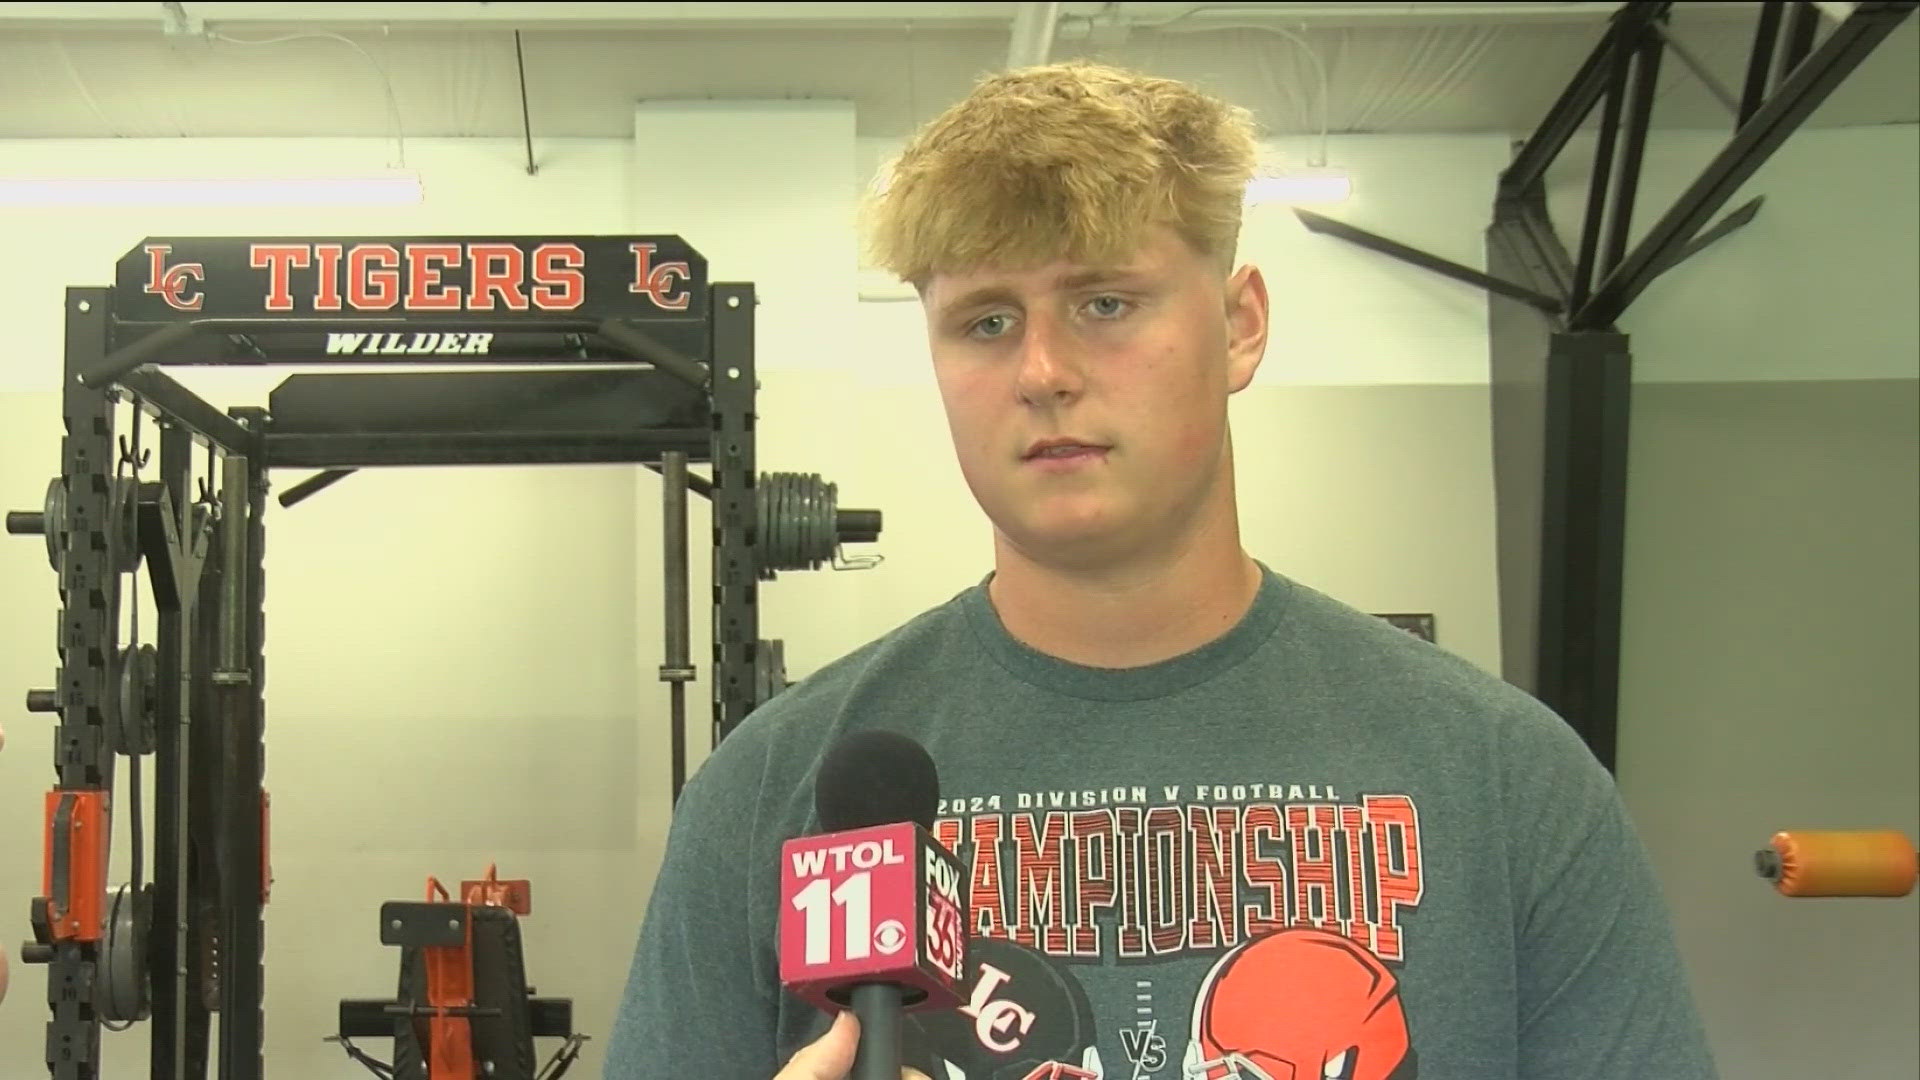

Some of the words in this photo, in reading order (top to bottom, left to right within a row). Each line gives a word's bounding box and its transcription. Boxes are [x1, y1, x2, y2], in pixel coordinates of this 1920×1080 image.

[144, 245, 204, 310] LC
[250, 244, 585, 310] TIGERS
[628, 243, 691, 310] LC
[326, 333, 494, 354] WILDER
[937, 795, 1001, 815] 2024
[1018, 786, 1147, 809] DIVISION
[1164, 785, 1180, 801] V
[1196, 782, 1340, 801] FOOTBALL
[792, 839, 905, 878] WTOL
[925, 844, 963, 912] FOX
[932, 794, 1424, 962] AMPIONSHIP
[791, 871, 871, 965] 11
[926, 896, 957, 971] 36
[957, 962, 1036, 1052] LC
[1118, 1026, 1167, 1072] VS
